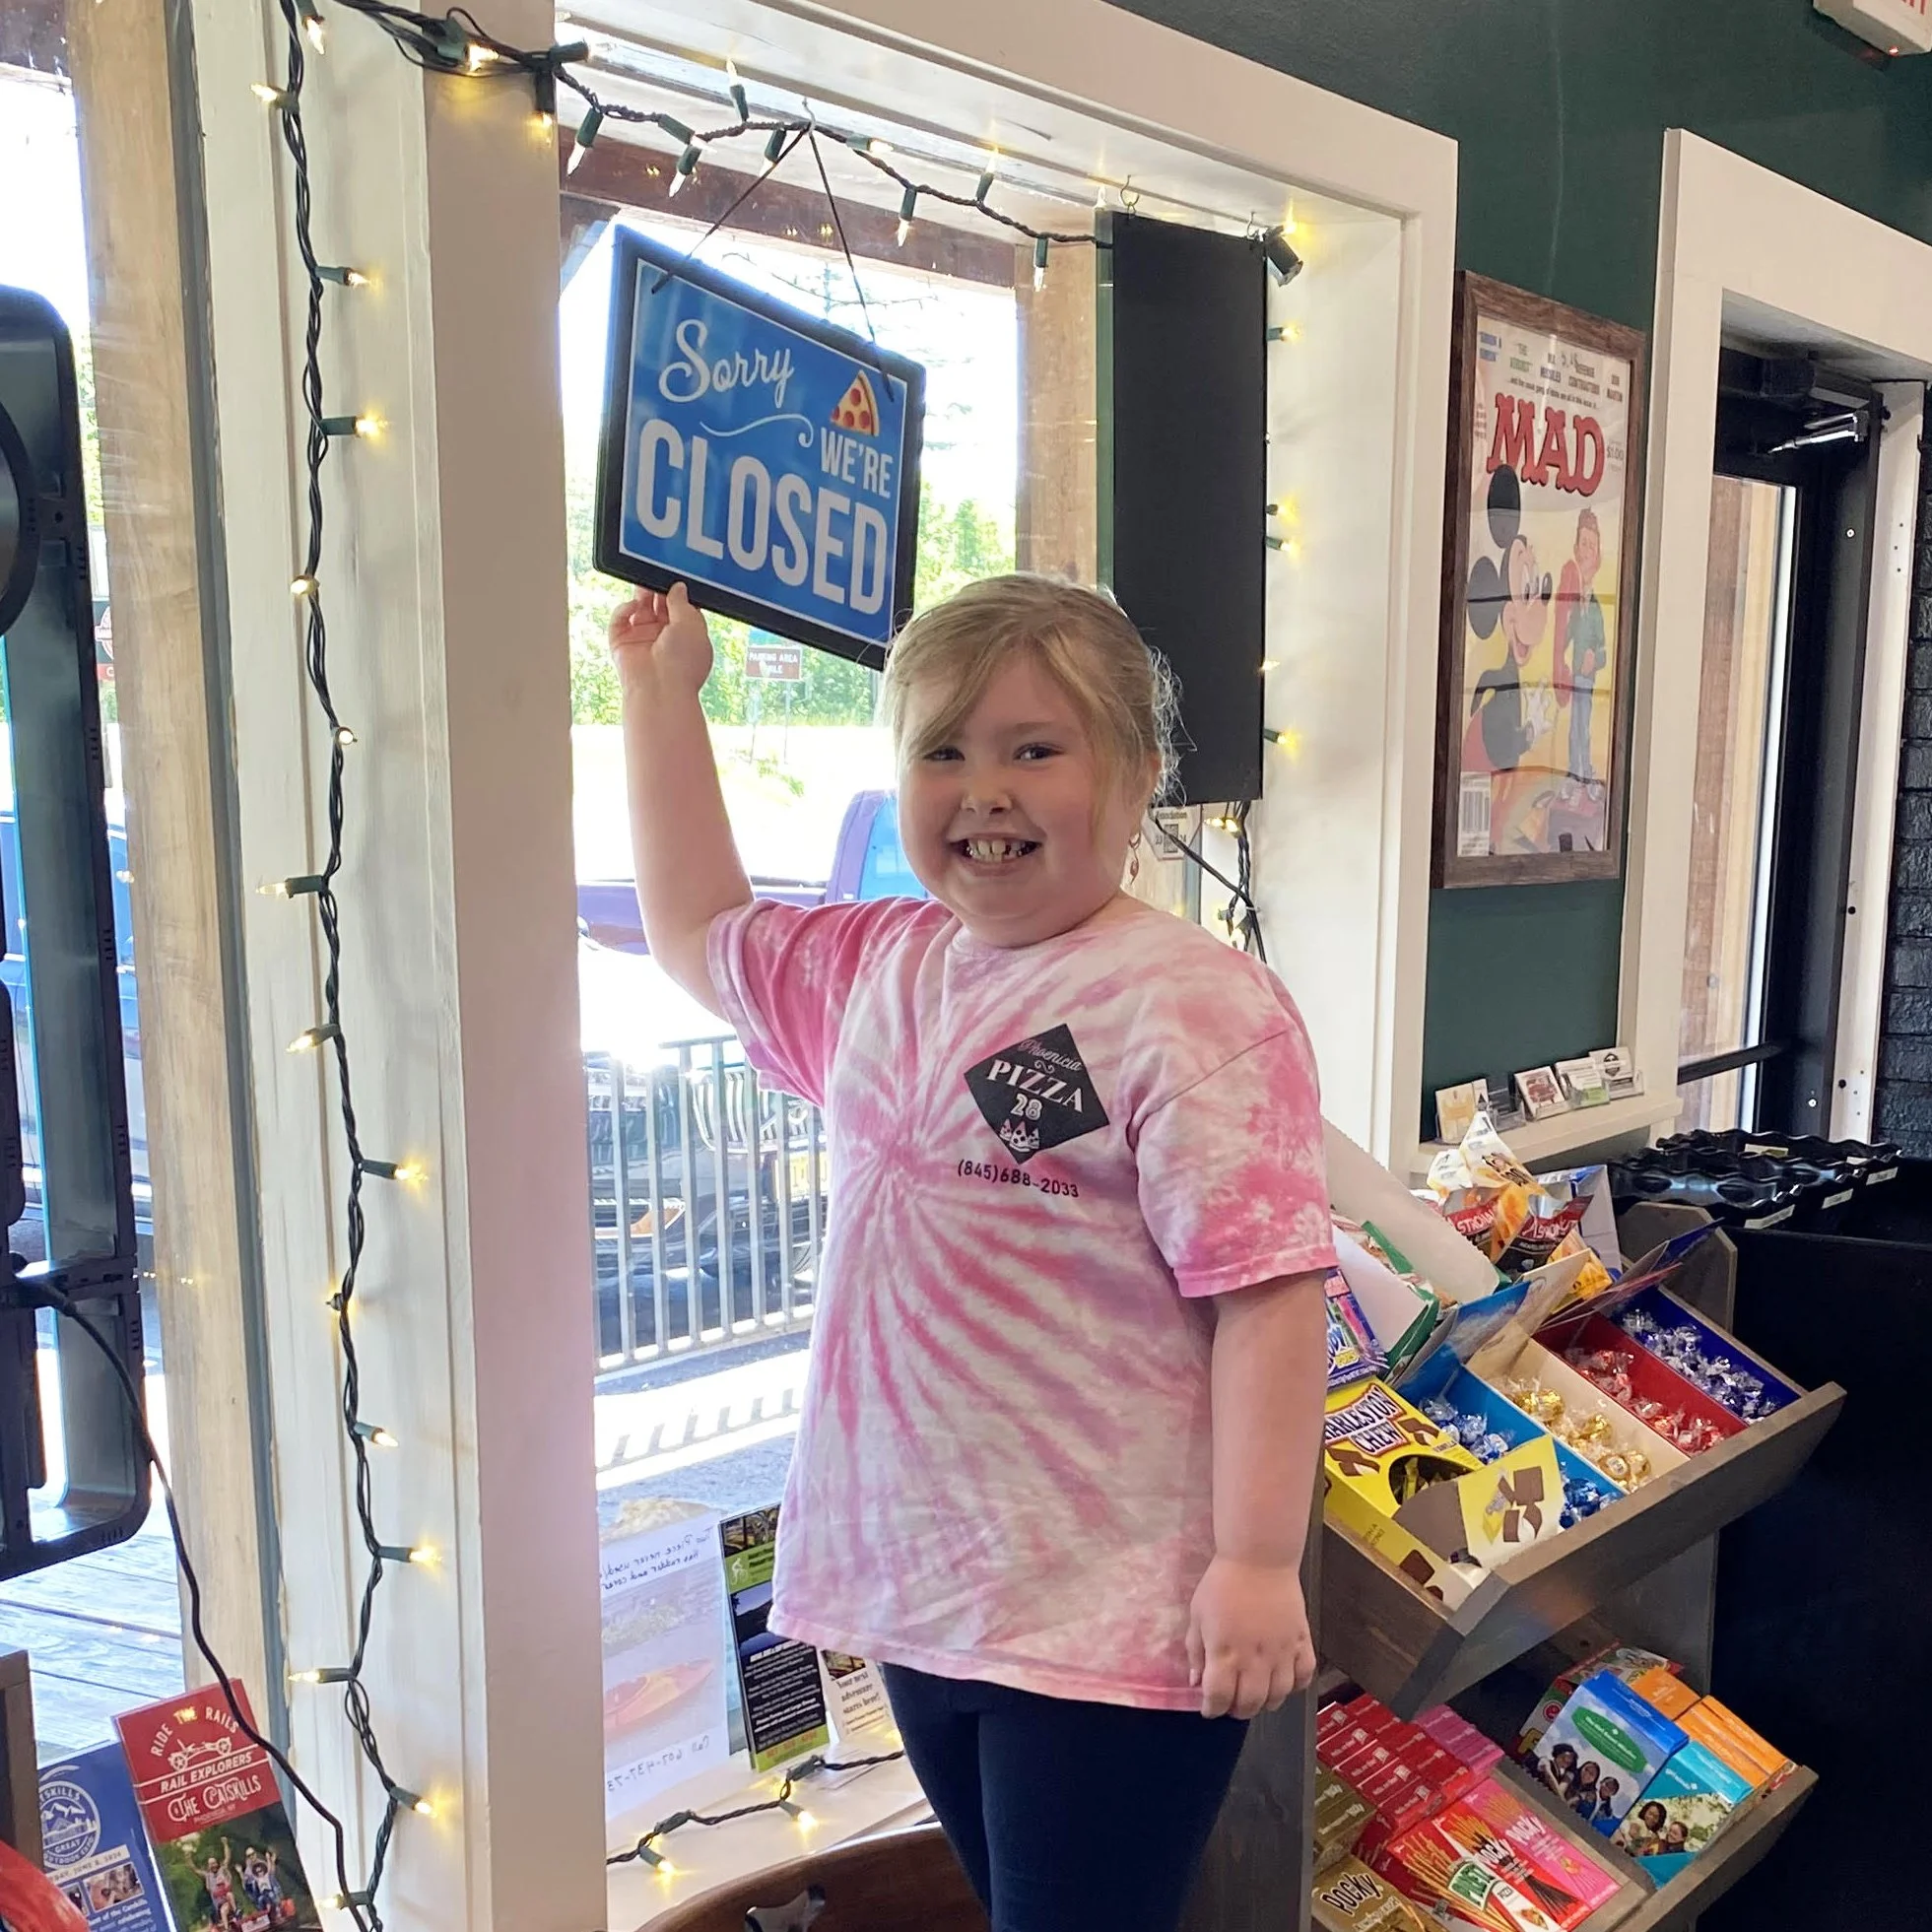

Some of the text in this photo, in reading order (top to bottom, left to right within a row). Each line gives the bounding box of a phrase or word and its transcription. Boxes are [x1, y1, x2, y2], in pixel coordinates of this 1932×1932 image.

[659, 319, 794, 408] Sorry
[821, 428, 893, 498] WE'RE
[1487, 393, 1605, 497] MAD
[636, 419, 887, 615] CLOSED
[1018, 1039, 1082, 1072] Phoenicia
[986, 1059, 1083, 1112] PIZZA
[1010, 1093, 1042, 1120] 28
[958, 1160, 1079, 1197] (845)688-2033
[1351, 1420, 1402, 1453] CHEW
[150, 1722, 173, 1757] RIDE
[205, 1706, 239, 1734] RAILS
[40, 1785, 82, 1803] TSKILLS
[161, 1751, 253, 1794] RAIL EXPLORERS
[167, 1775, 262, 1823] THE CATSKILLS
[54, 1838, 82, 1853] GREAT
